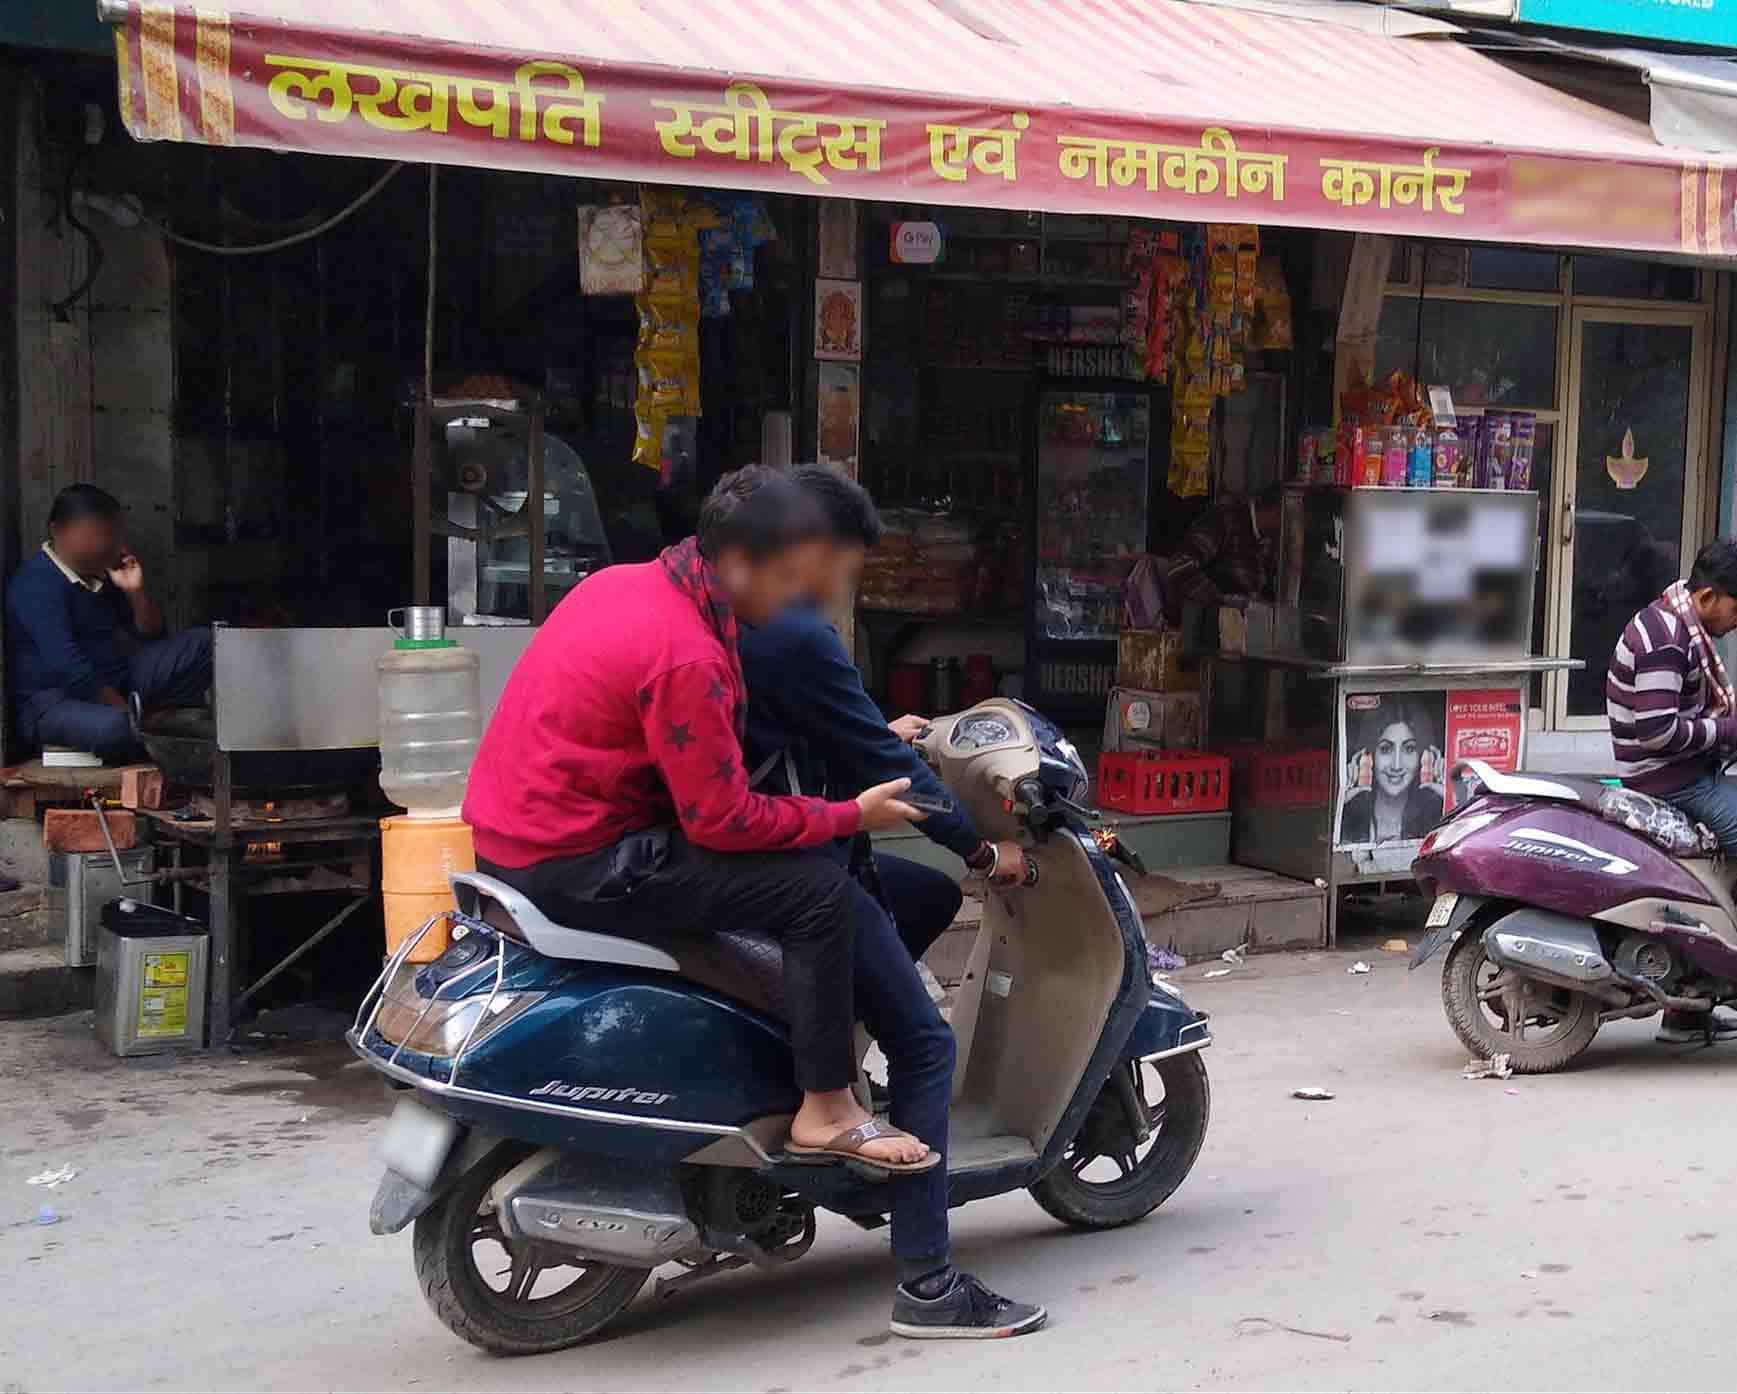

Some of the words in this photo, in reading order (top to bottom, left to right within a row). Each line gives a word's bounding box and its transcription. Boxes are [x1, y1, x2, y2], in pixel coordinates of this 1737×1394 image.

[264, 57, 604, 147] लखपति
[652, 83, 886, 184] स्वीट्स
[926, 112, 1030, 181] एवं
[1057, 128, 1286, 201] नमकीन
[1320, 147, 1471, 214] कार्नर
[1500, 840, 1593, 863] Jupiter
[529, 1079, 678, 1105] Jupiter
